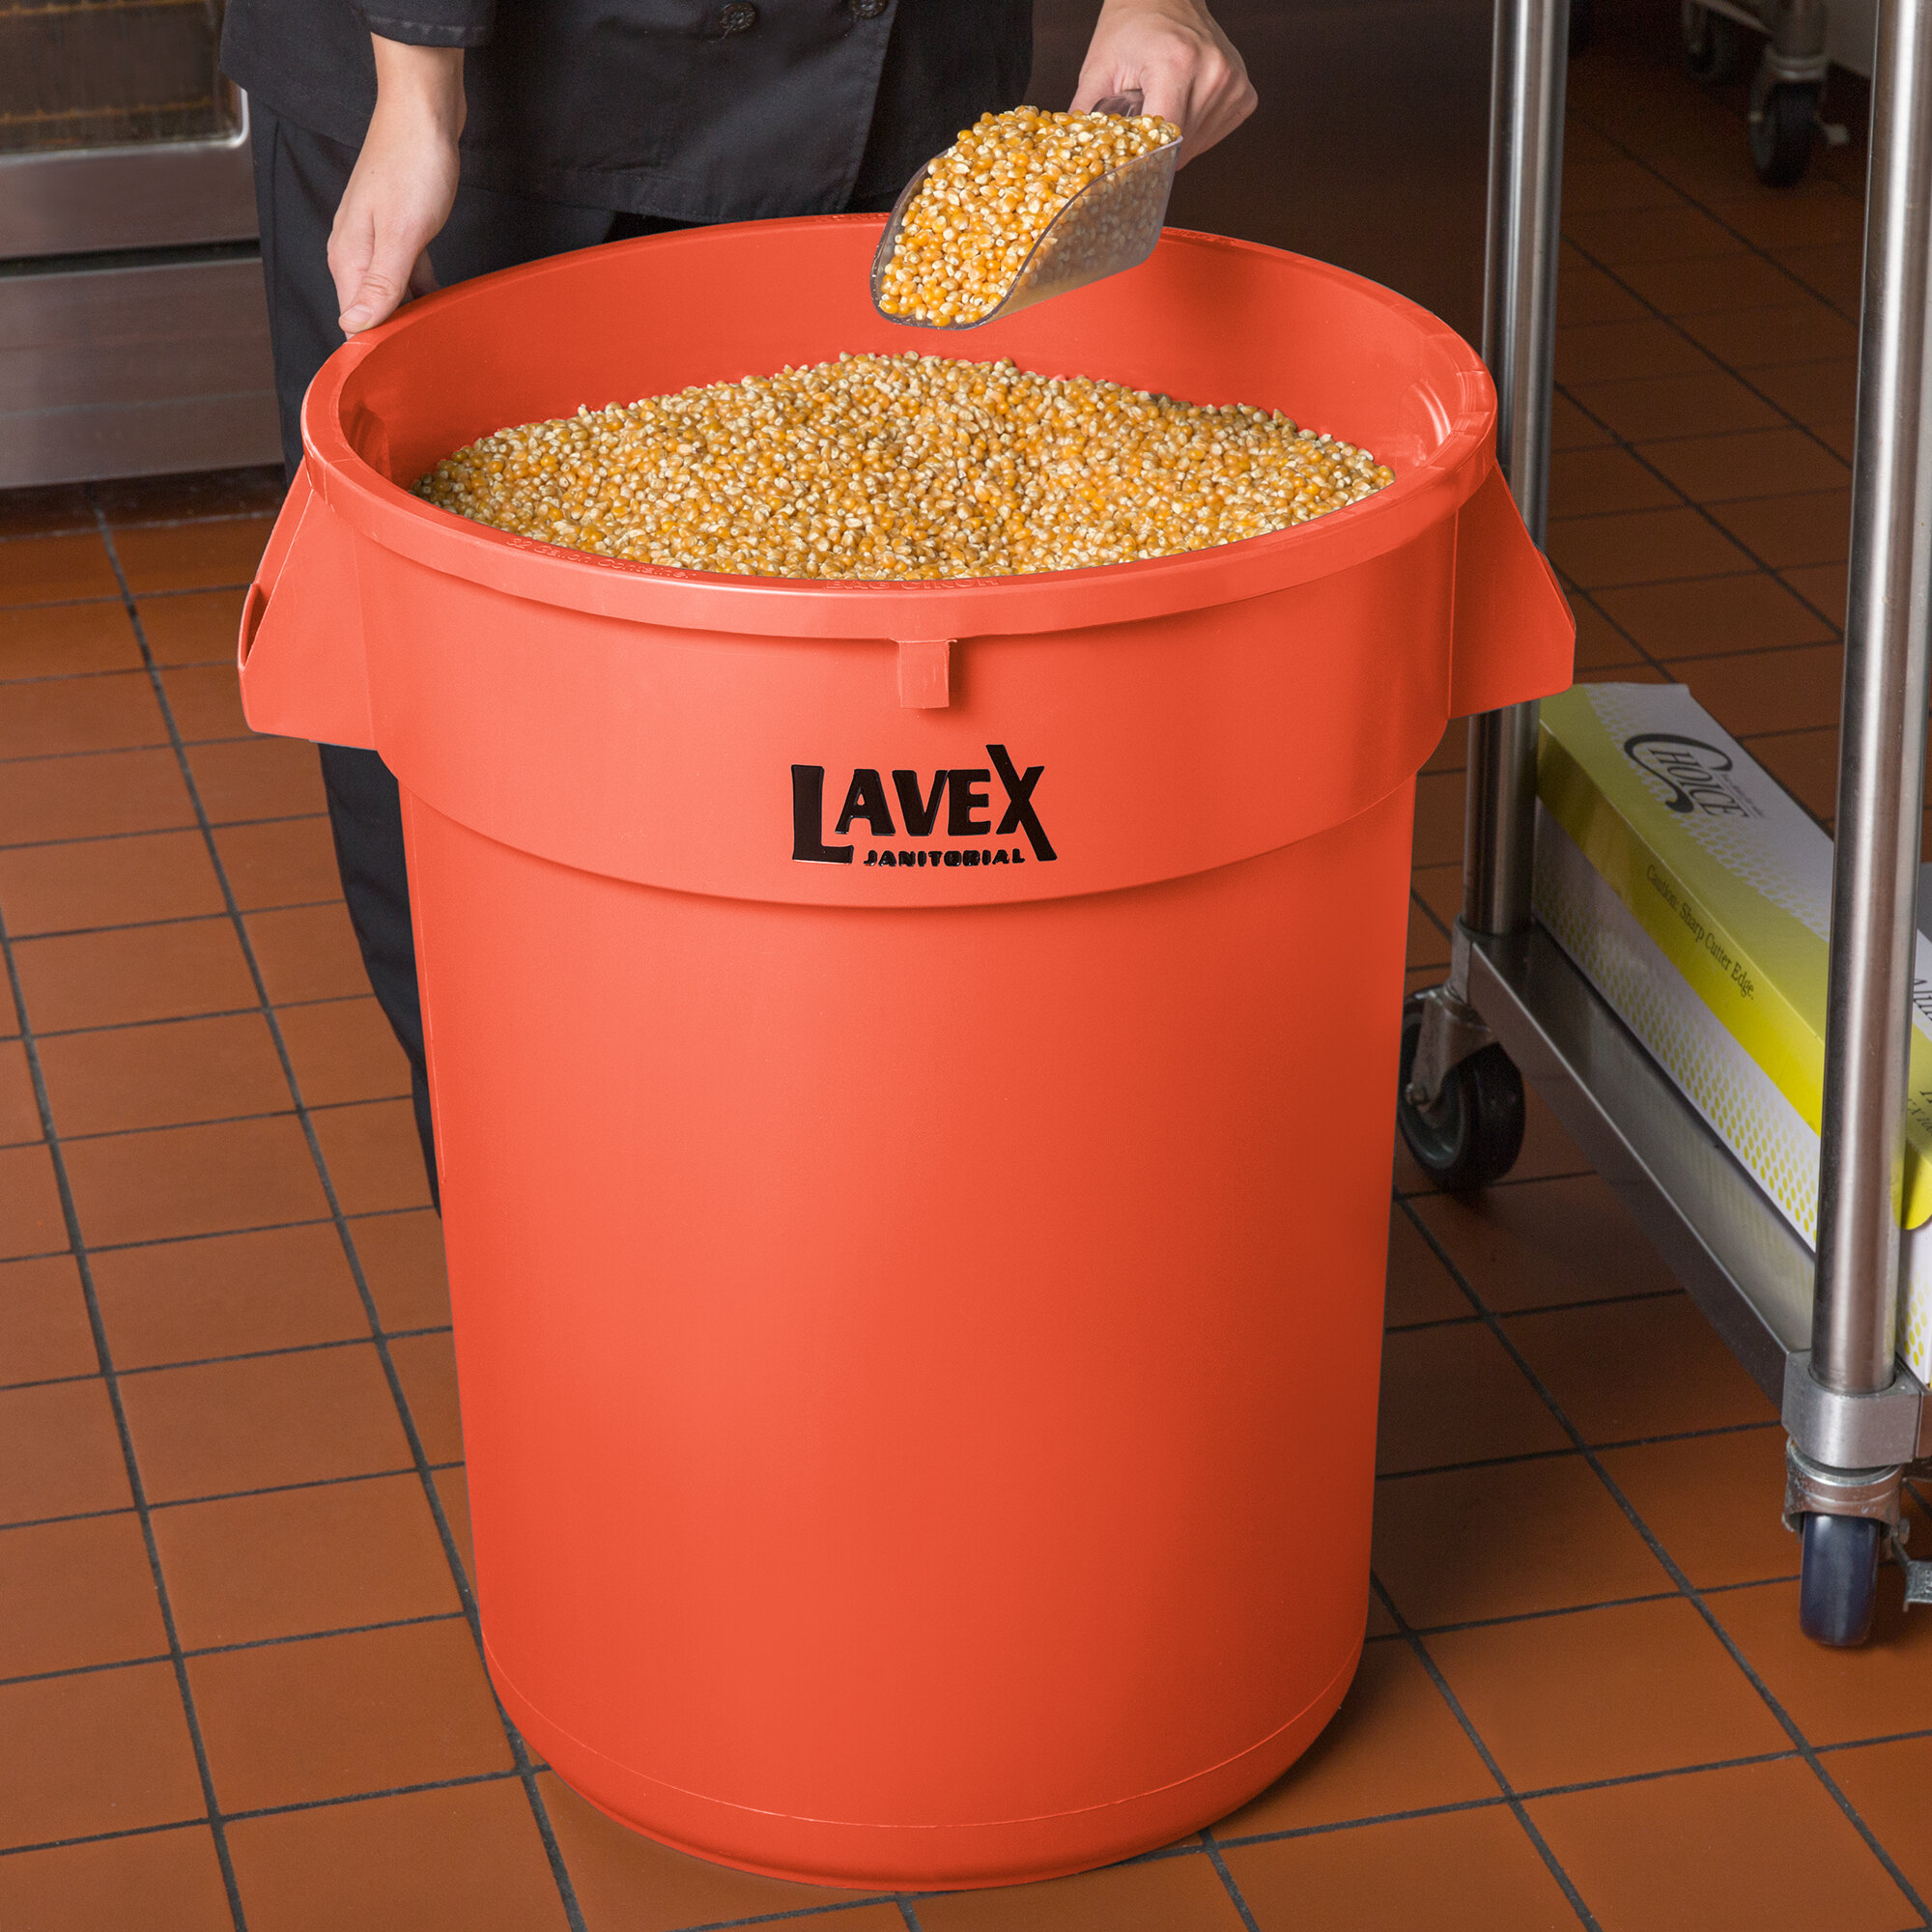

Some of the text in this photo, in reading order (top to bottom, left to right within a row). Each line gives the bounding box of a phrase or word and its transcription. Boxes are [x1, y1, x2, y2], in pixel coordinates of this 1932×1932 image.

[790, 744, 1058, 864] LAVEX
[1624, 732, 1750, 817] CHOICE
[864, 848, 1027, 867] JANITORIAL
[1680, 902, 1705, 943] Sharp
[1705, 932, 1732, 972] Cutter
[1731, 962, 1755, 1001] Edge.
